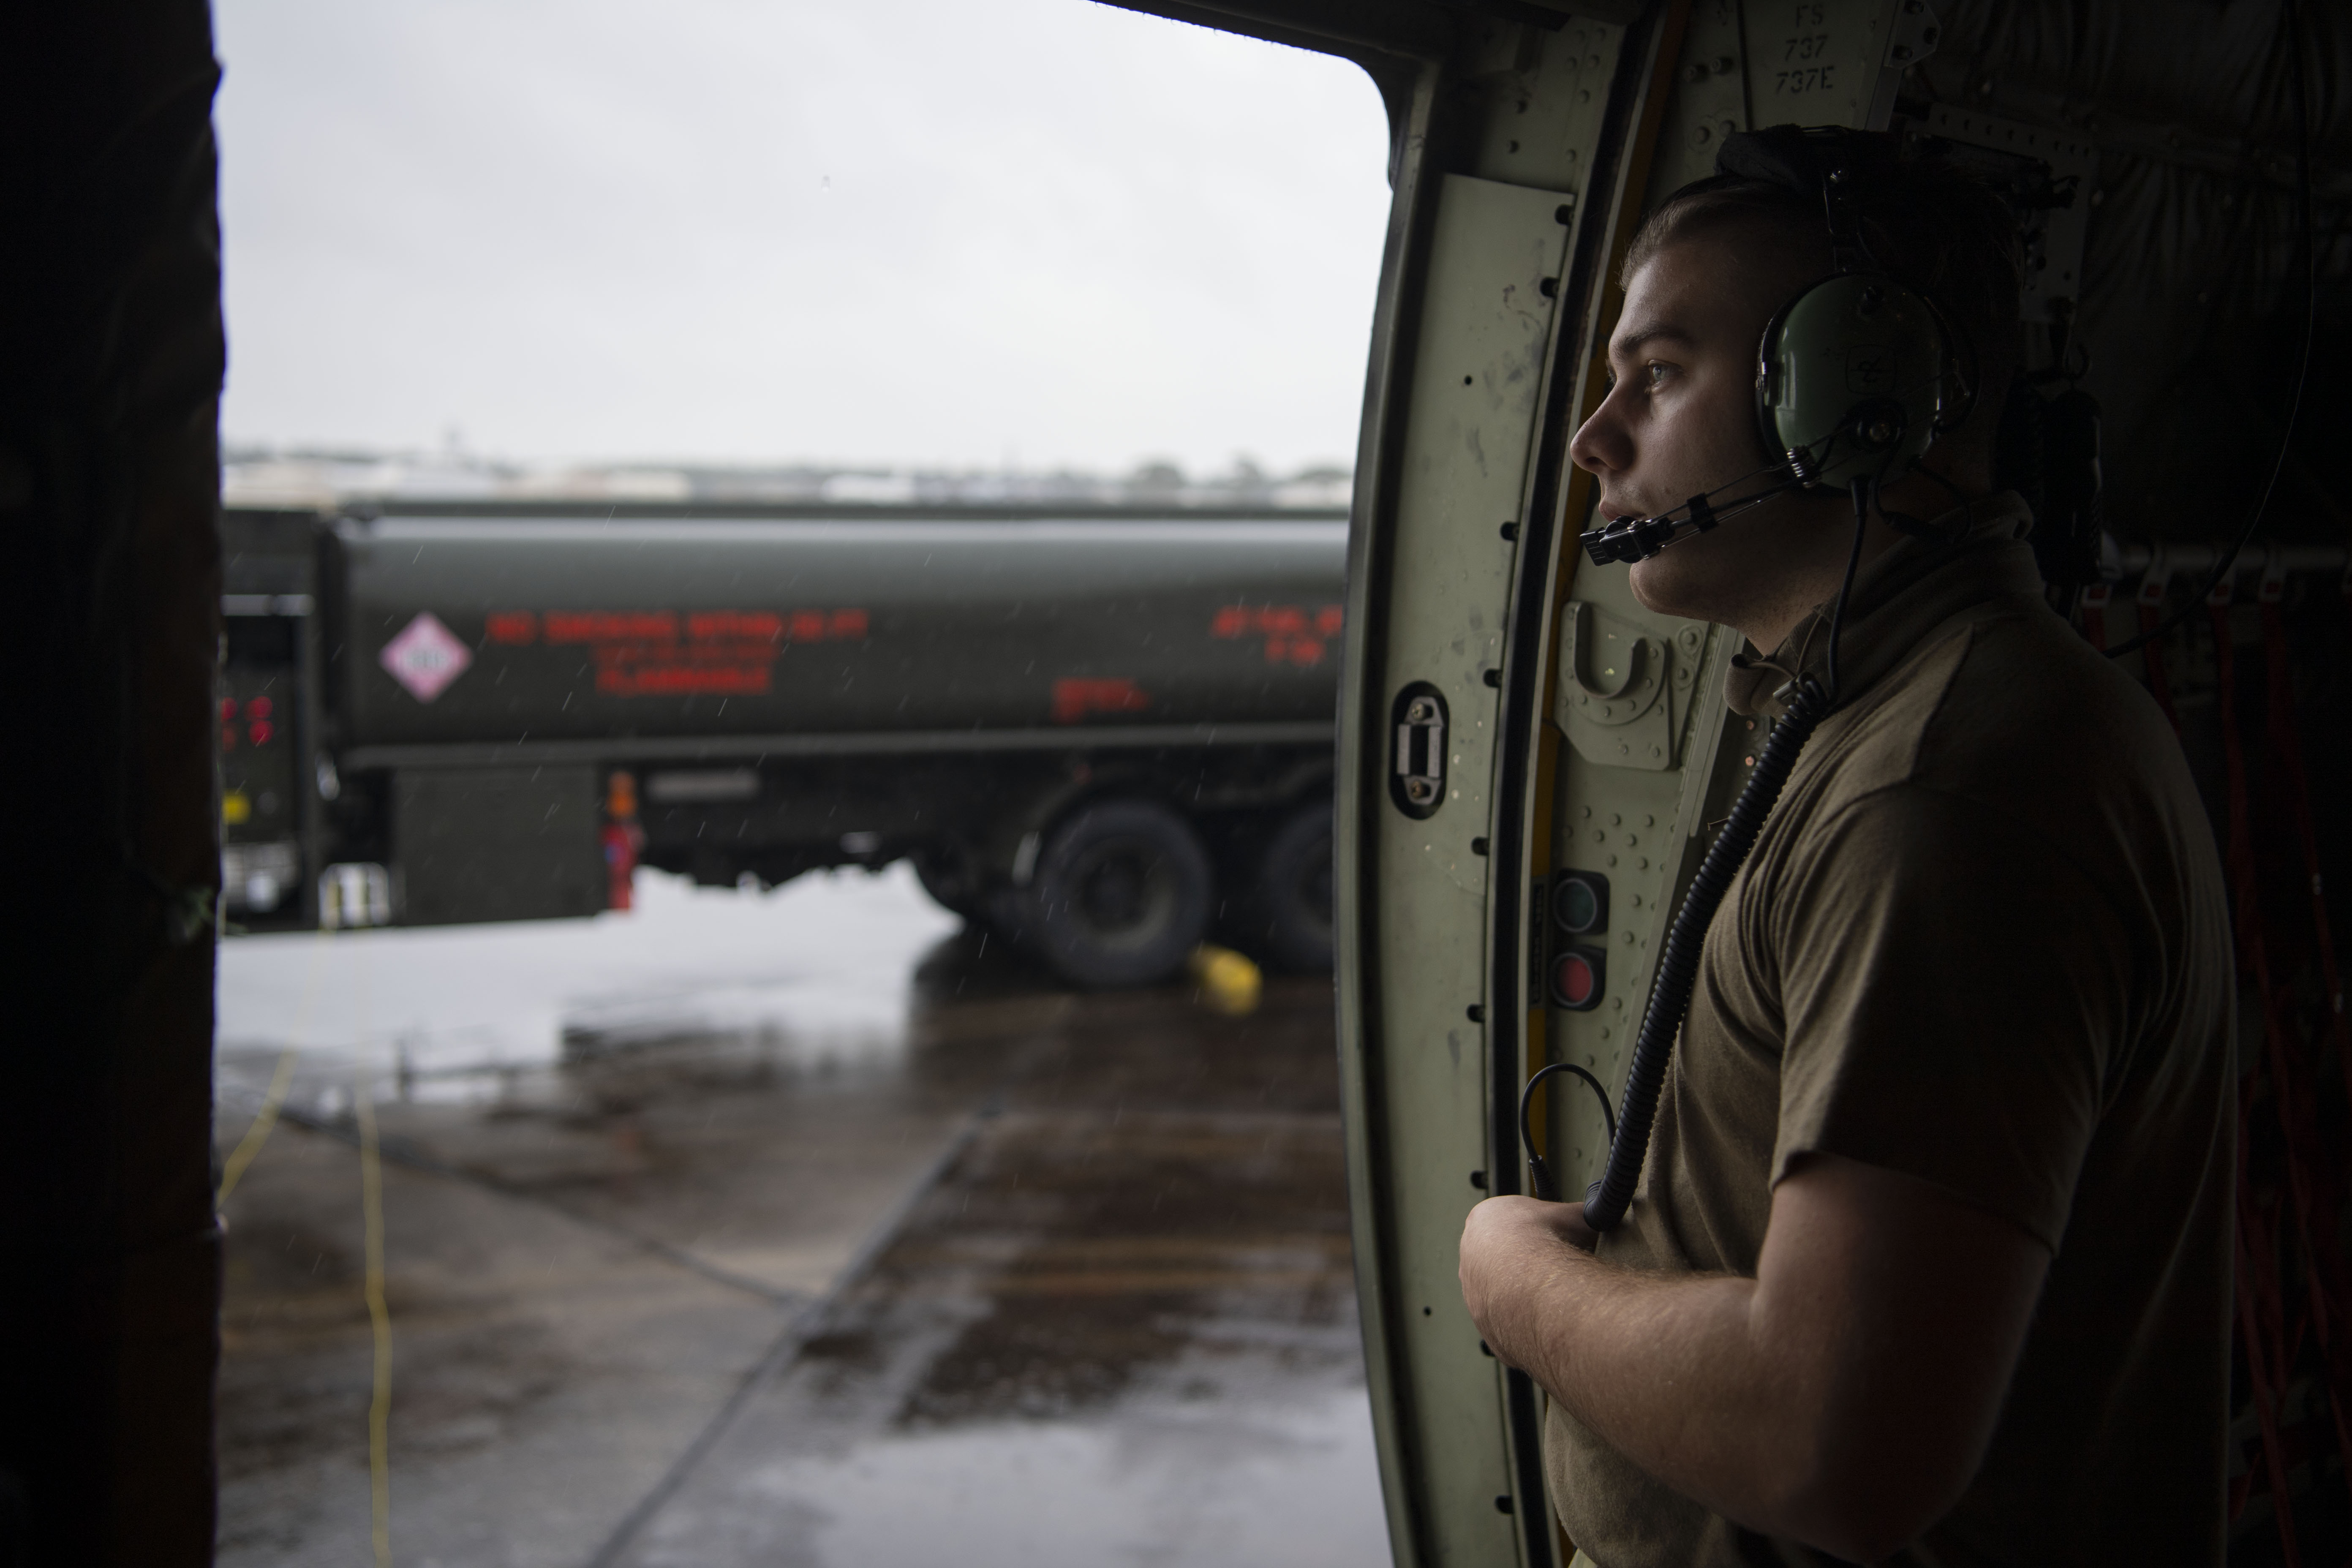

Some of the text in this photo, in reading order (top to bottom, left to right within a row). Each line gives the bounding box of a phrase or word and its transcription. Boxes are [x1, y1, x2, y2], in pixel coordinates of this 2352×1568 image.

[1796, 4, 1824, 27] FS
[1785, 35, 1828, 61] 737
[1776, 65, 1835, 94] 737E
